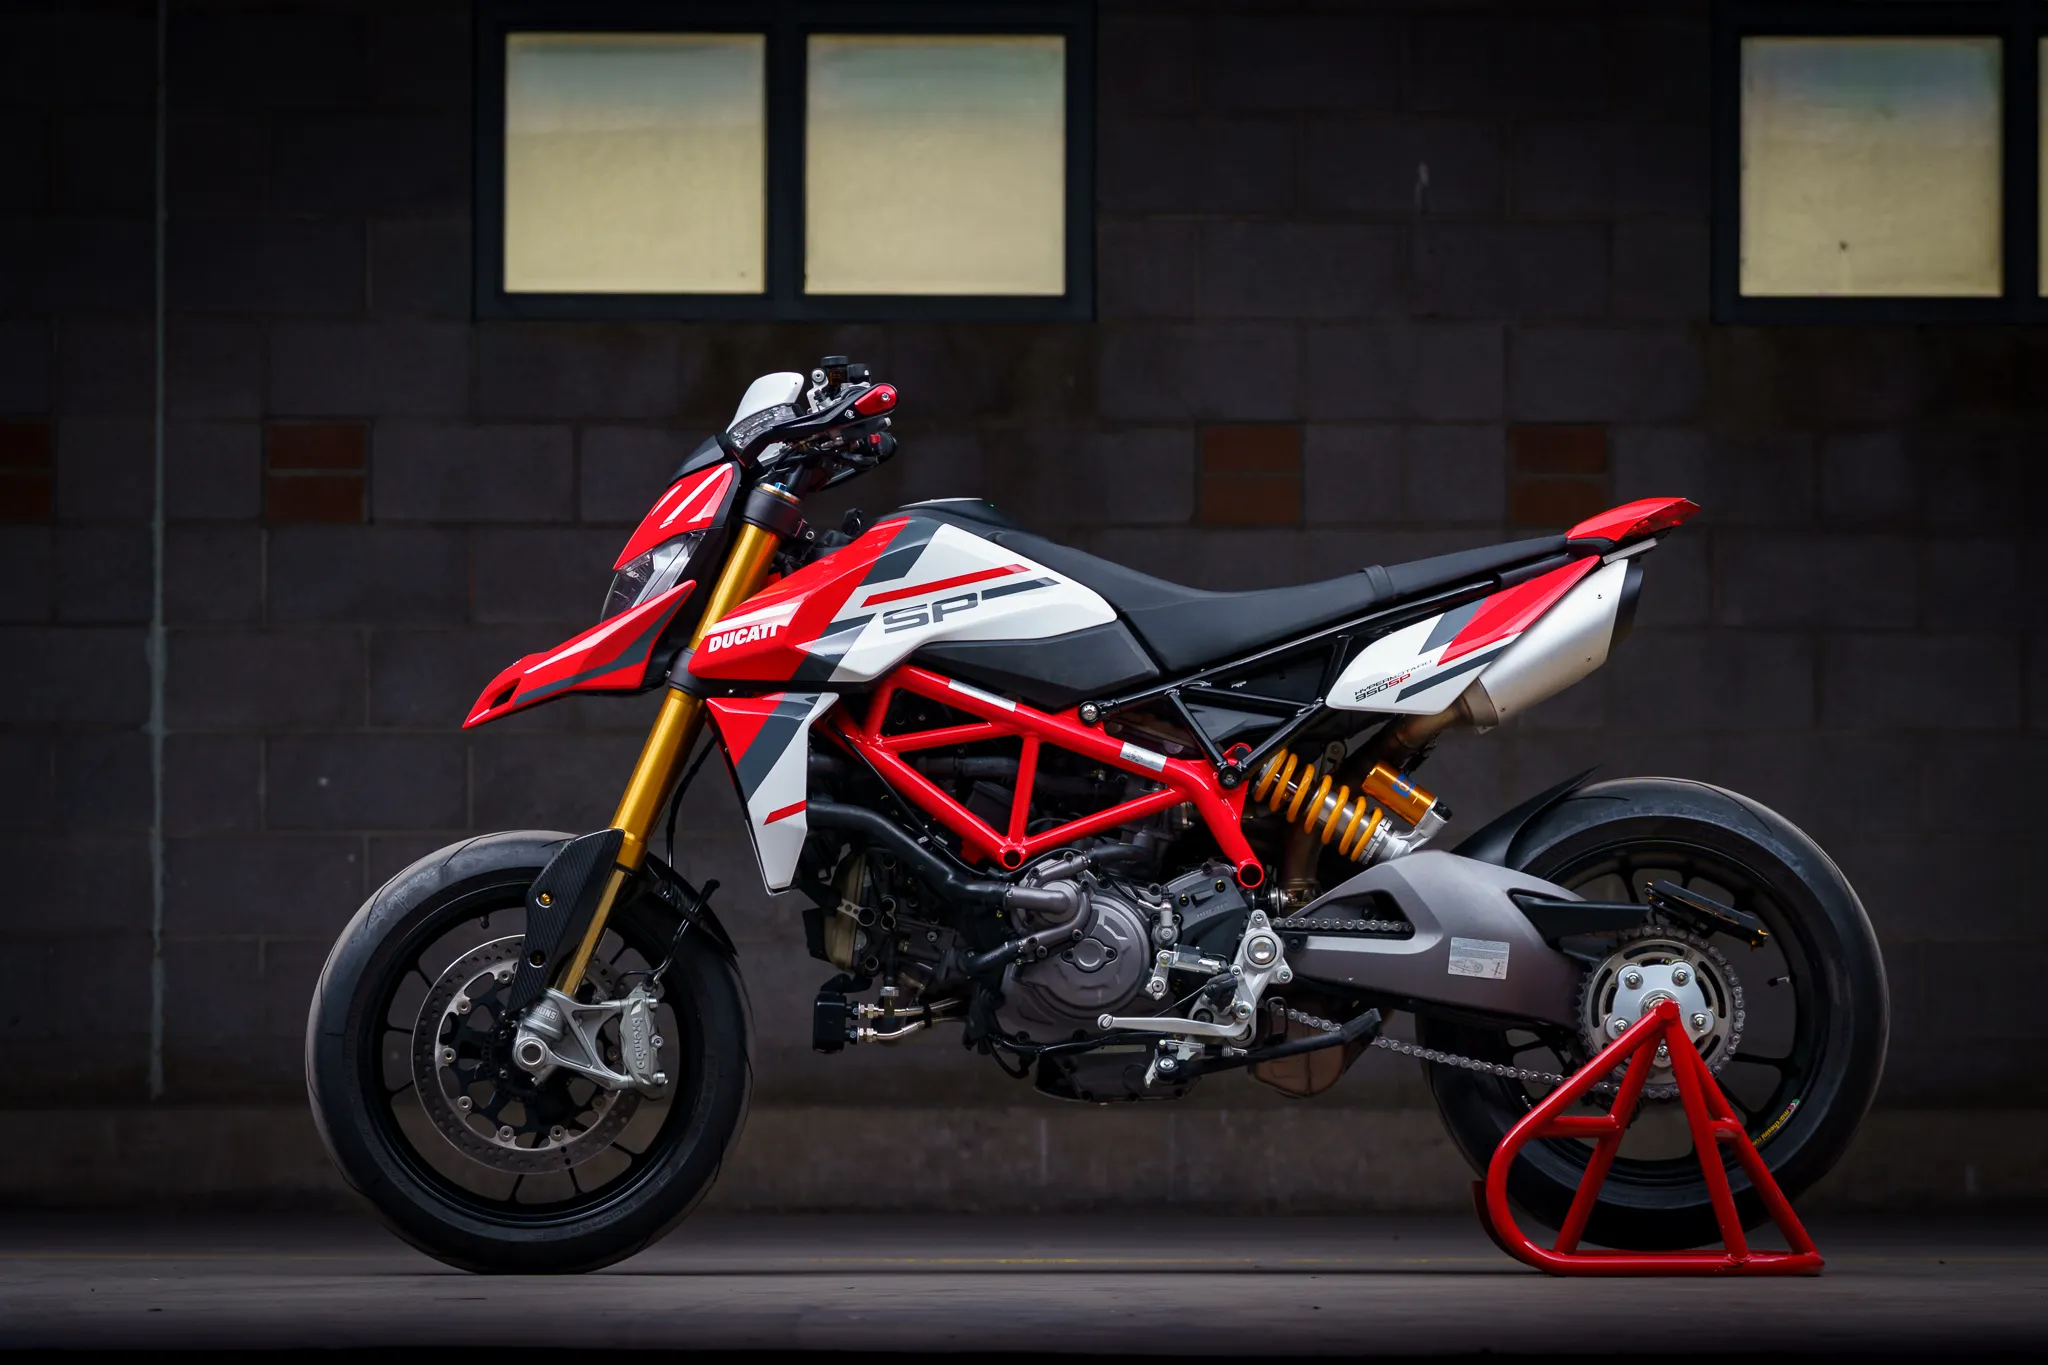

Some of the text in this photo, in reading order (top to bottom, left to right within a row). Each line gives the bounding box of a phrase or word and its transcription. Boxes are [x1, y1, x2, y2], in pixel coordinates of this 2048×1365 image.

[883, 591, 979, 635] SP
[708, 622, 779, 653] DUCATI
[631, 1016, 647, 1070] brembo
